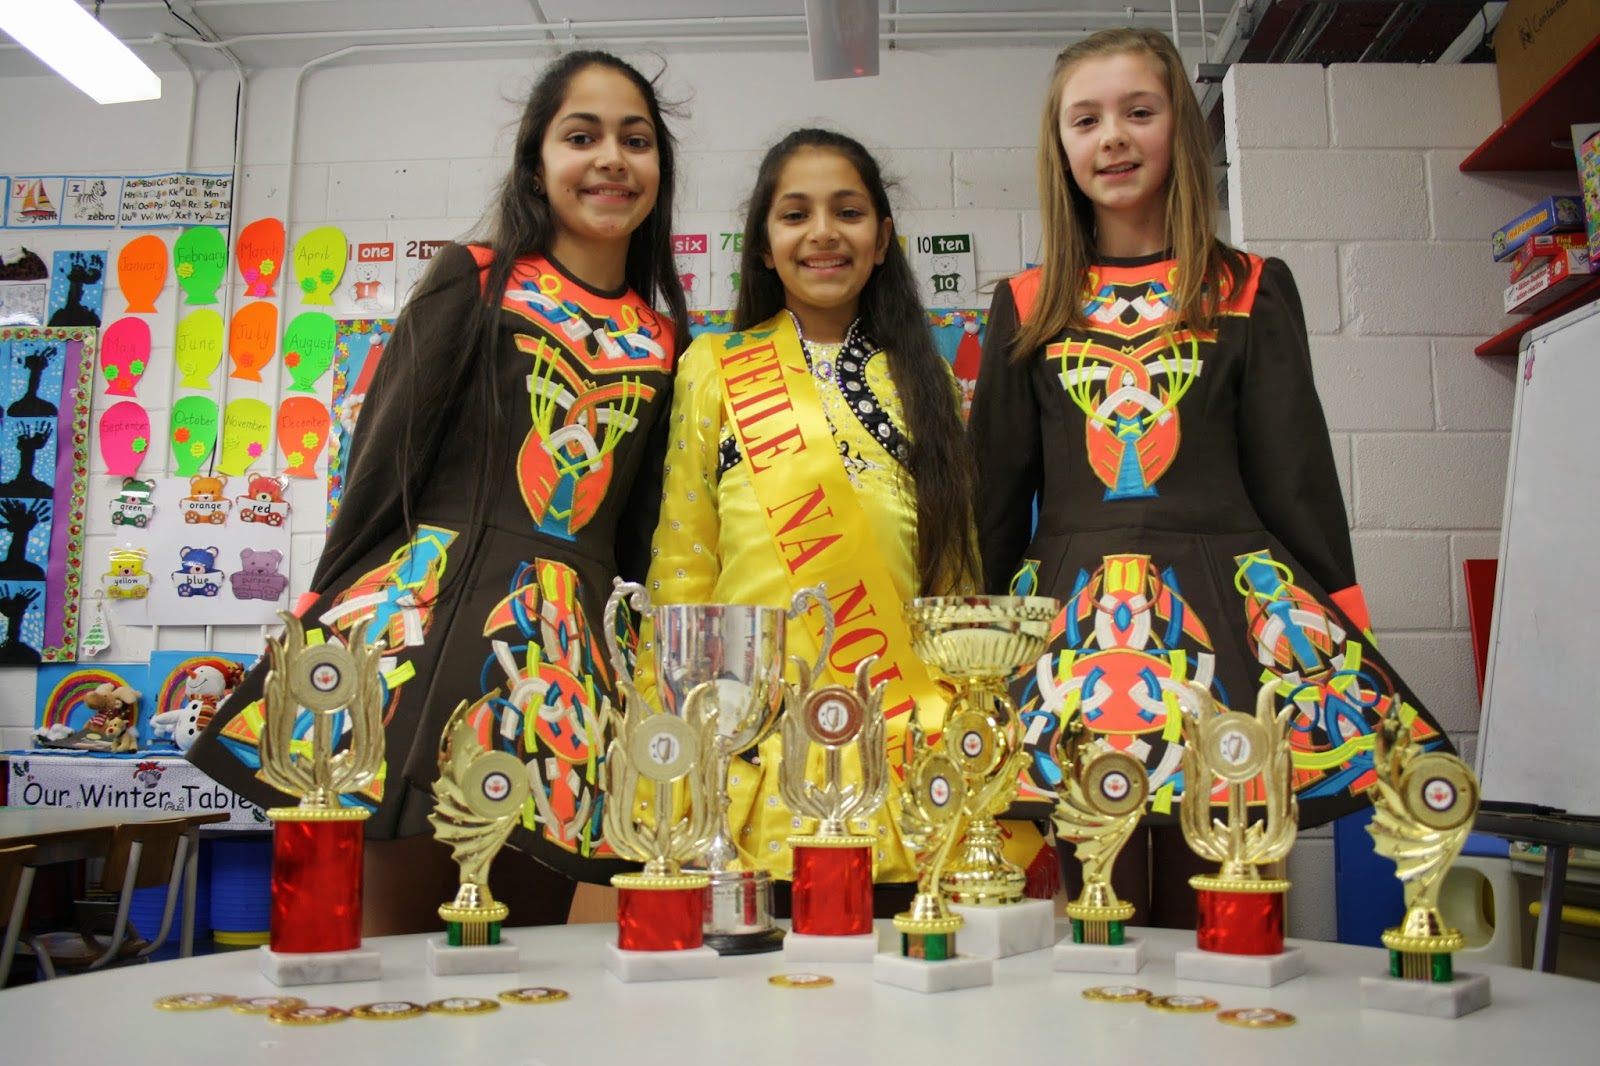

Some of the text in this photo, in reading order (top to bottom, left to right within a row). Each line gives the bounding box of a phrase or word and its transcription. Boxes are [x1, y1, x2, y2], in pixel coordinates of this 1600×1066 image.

[16, 184, 25, 195] y
[32, 212, 58, 223] yacht
[88, 211, 115, 220] zebra
[675, 237, 702, 251] six
[720, 233, 733, 250] 7
[917, 236, 964, 253] 10 ten
[241, 243, 279, 257] March
[298, 246, 331, 266] April
[361, 247, 390, 258] one
[406, 241, 445, 258] 2 tw
[178, 248, 225, 268] February
[119, 259, 164, 280] January
[939, 277, 955, 290] 10
[179, 335, 215, 351] June
[236, 325, 270, 349] July
[107, 338, 136, 357] May
[290, 334, 333, 356] August
[175, 411, 215, 426] October
[225, 414, 267, 431] November
[282, 416, 328, 428] December
[101, 421, 149, 434] September
[120, 504, 142, 512] green
[189, 501, 222, 512] orange
[252, 504, 271, 514] red
[767, 483, 843, 575] NA
[114, 577, 138, 585] yellow
[186, 575, 209, 585] blue
[242, 576, 271, 587] purple
[23, 783, 70, 807] Our
[80, 783, 170, 809] Winter
